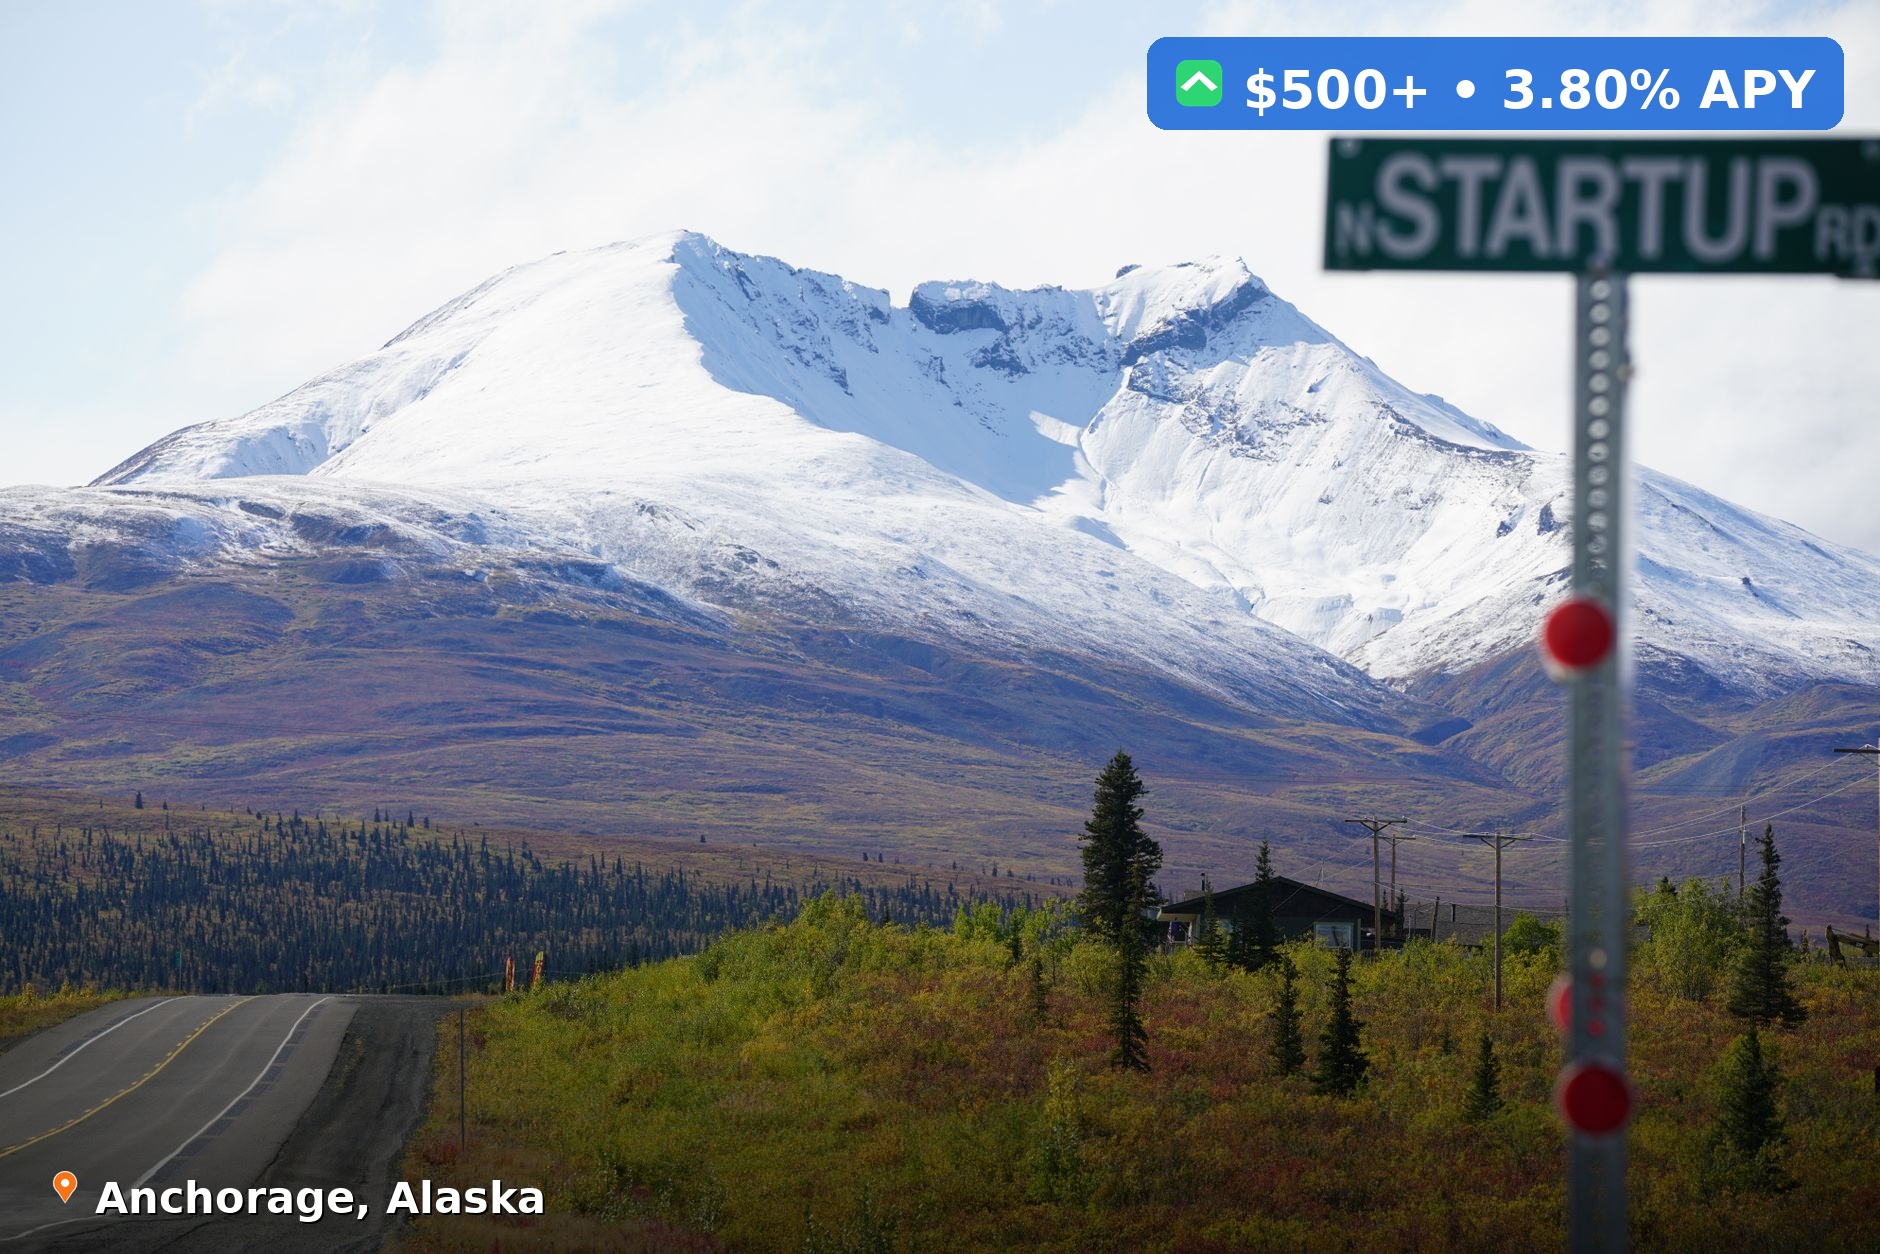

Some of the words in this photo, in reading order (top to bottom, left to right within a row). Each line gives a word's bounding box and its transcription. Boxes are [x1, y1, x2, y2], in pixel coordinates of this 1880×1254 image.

[1335, 201, 1374, 257] N
[1376, 153, 1819, 261] STARTUP
[1816, 205, 1880, 258] RD
